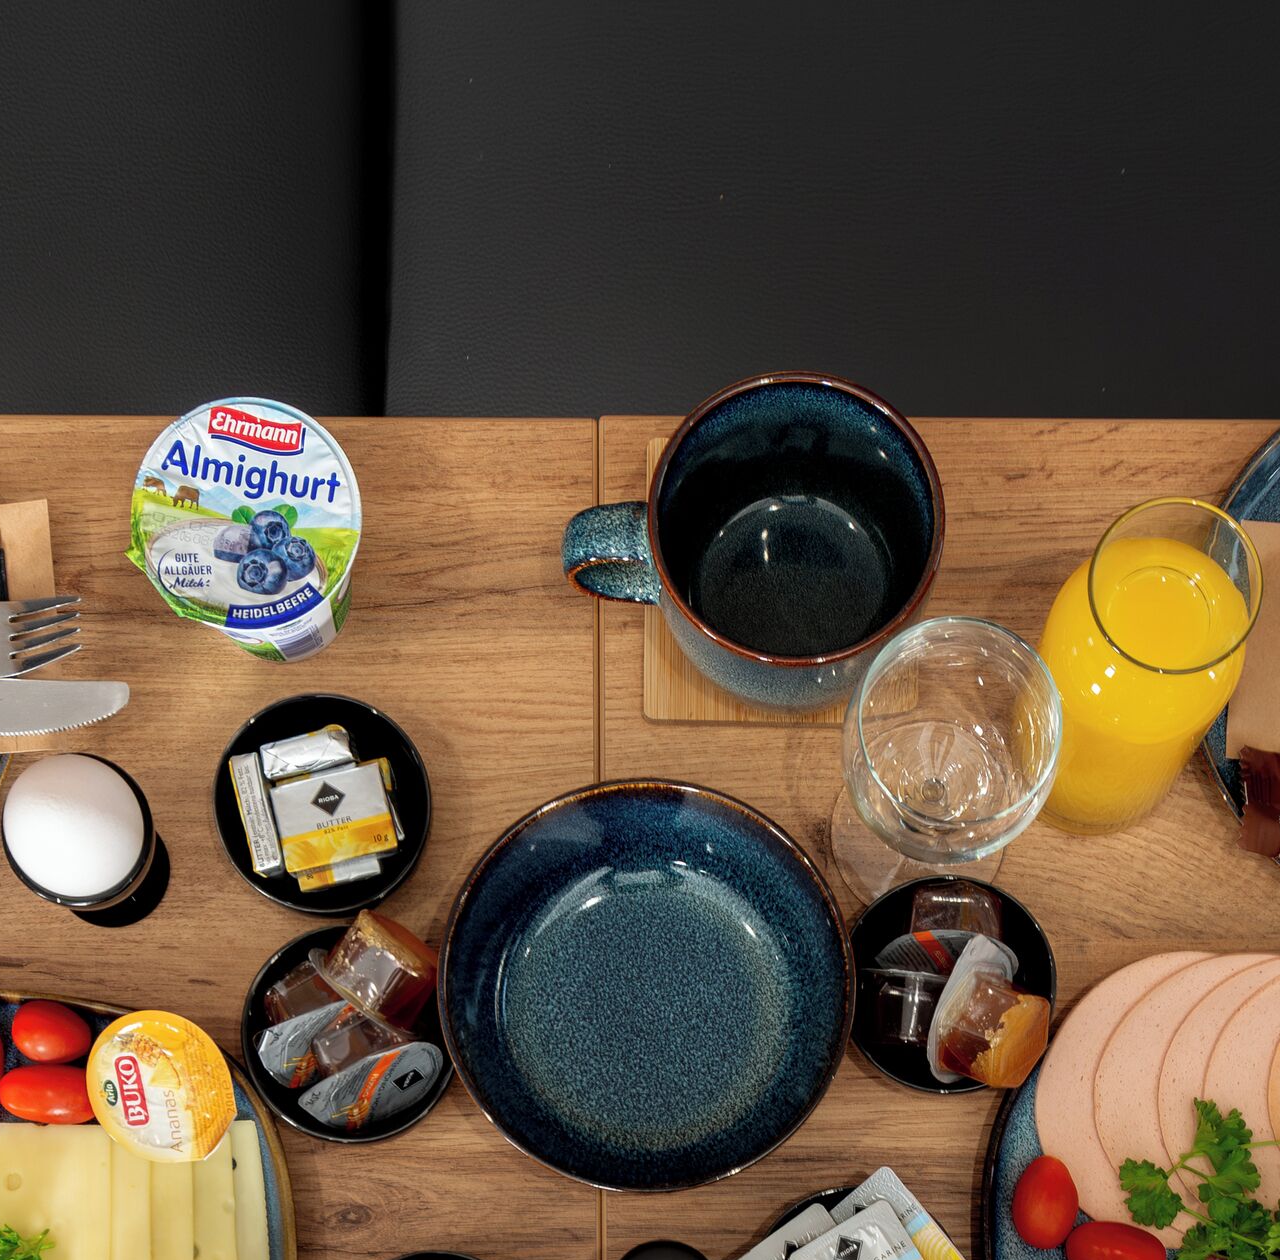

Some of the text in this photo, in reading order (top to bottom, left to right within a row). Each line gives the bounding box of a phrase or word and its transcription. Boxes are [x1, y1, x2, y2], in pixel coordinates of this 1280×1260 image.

[211, 412, 298, 445] Ehrmann
[161, 440, 340, 503] Almighurt
[175, 552, 199, 563] GUTE
[164, 563, 212, 575] ALLGÄUER
[232, 586, 314, 619] HEIDELBEERE
[318, 793, 339, 803] RIOBA
[316, 816, 352, 830] BUTTER
[373, 834, 382, 843] 10
[106, 1083, 117, 1103] Arla
[118, 1059, 145, 1122] BUKO
[163, 1090, 183, 1153] Ananas
